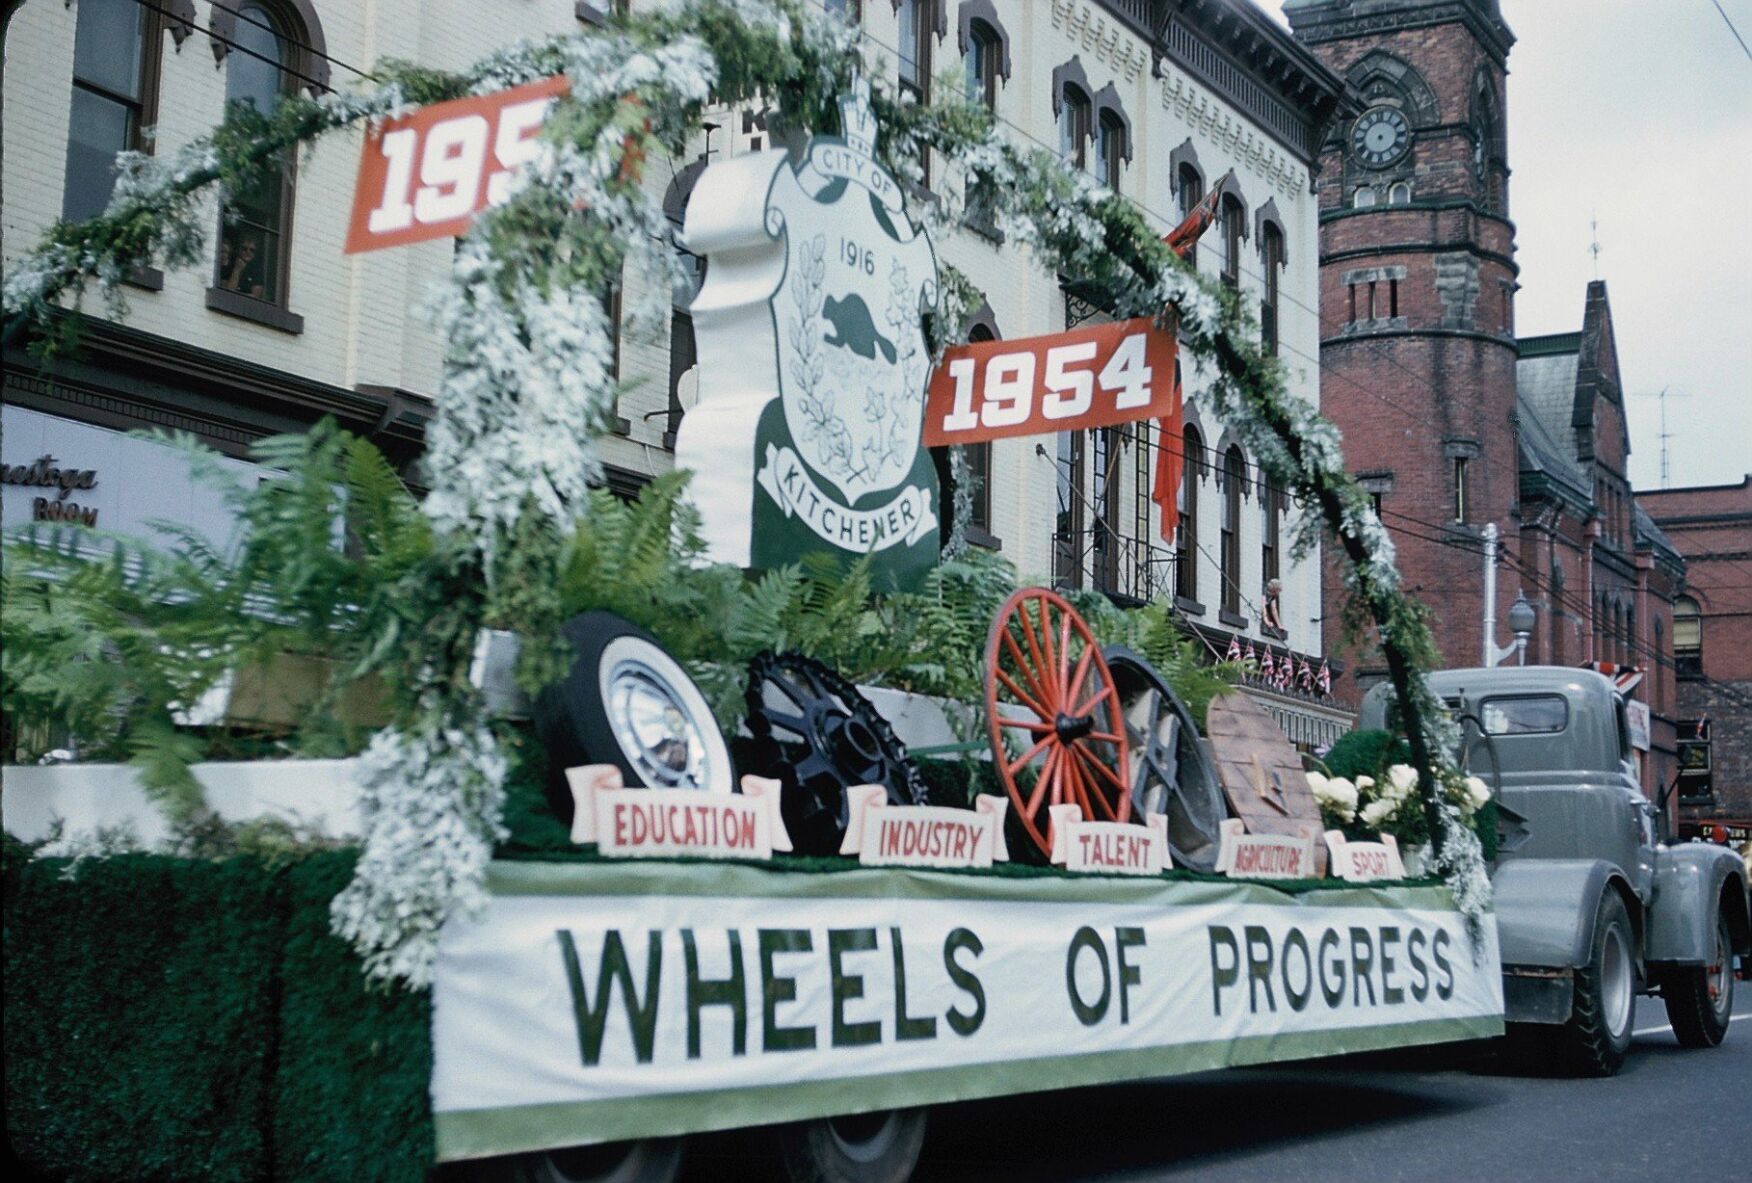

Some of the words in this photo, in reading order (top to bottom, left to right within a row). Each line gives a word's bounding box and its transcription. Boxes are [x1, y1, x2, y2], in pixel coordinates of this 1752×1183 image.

[368, 98, 562, 233] 195
[823, 149, 863, 174] CITY
[871, 170, 891, 194] OF
[840, 237, 875, 275] 1916
[943, 333, 1152, 431] 1954
[784, 464, 915, 543] KITCHENER
[614, 804, 756, 849] EDUCATION
[879, 819, 983, 860] INDUSTRY
[1079, 834, 1151, 868] TALENT
[1235, 843, 1302, 875] AGRICULTURE
[1352, 851, 1388, 876] SPORT
[555, 926, 987, 1067] WHEELS
[1066, 925, 1147, 1027] OF
[1208, 925, 1455, 1017] PROGRESS
